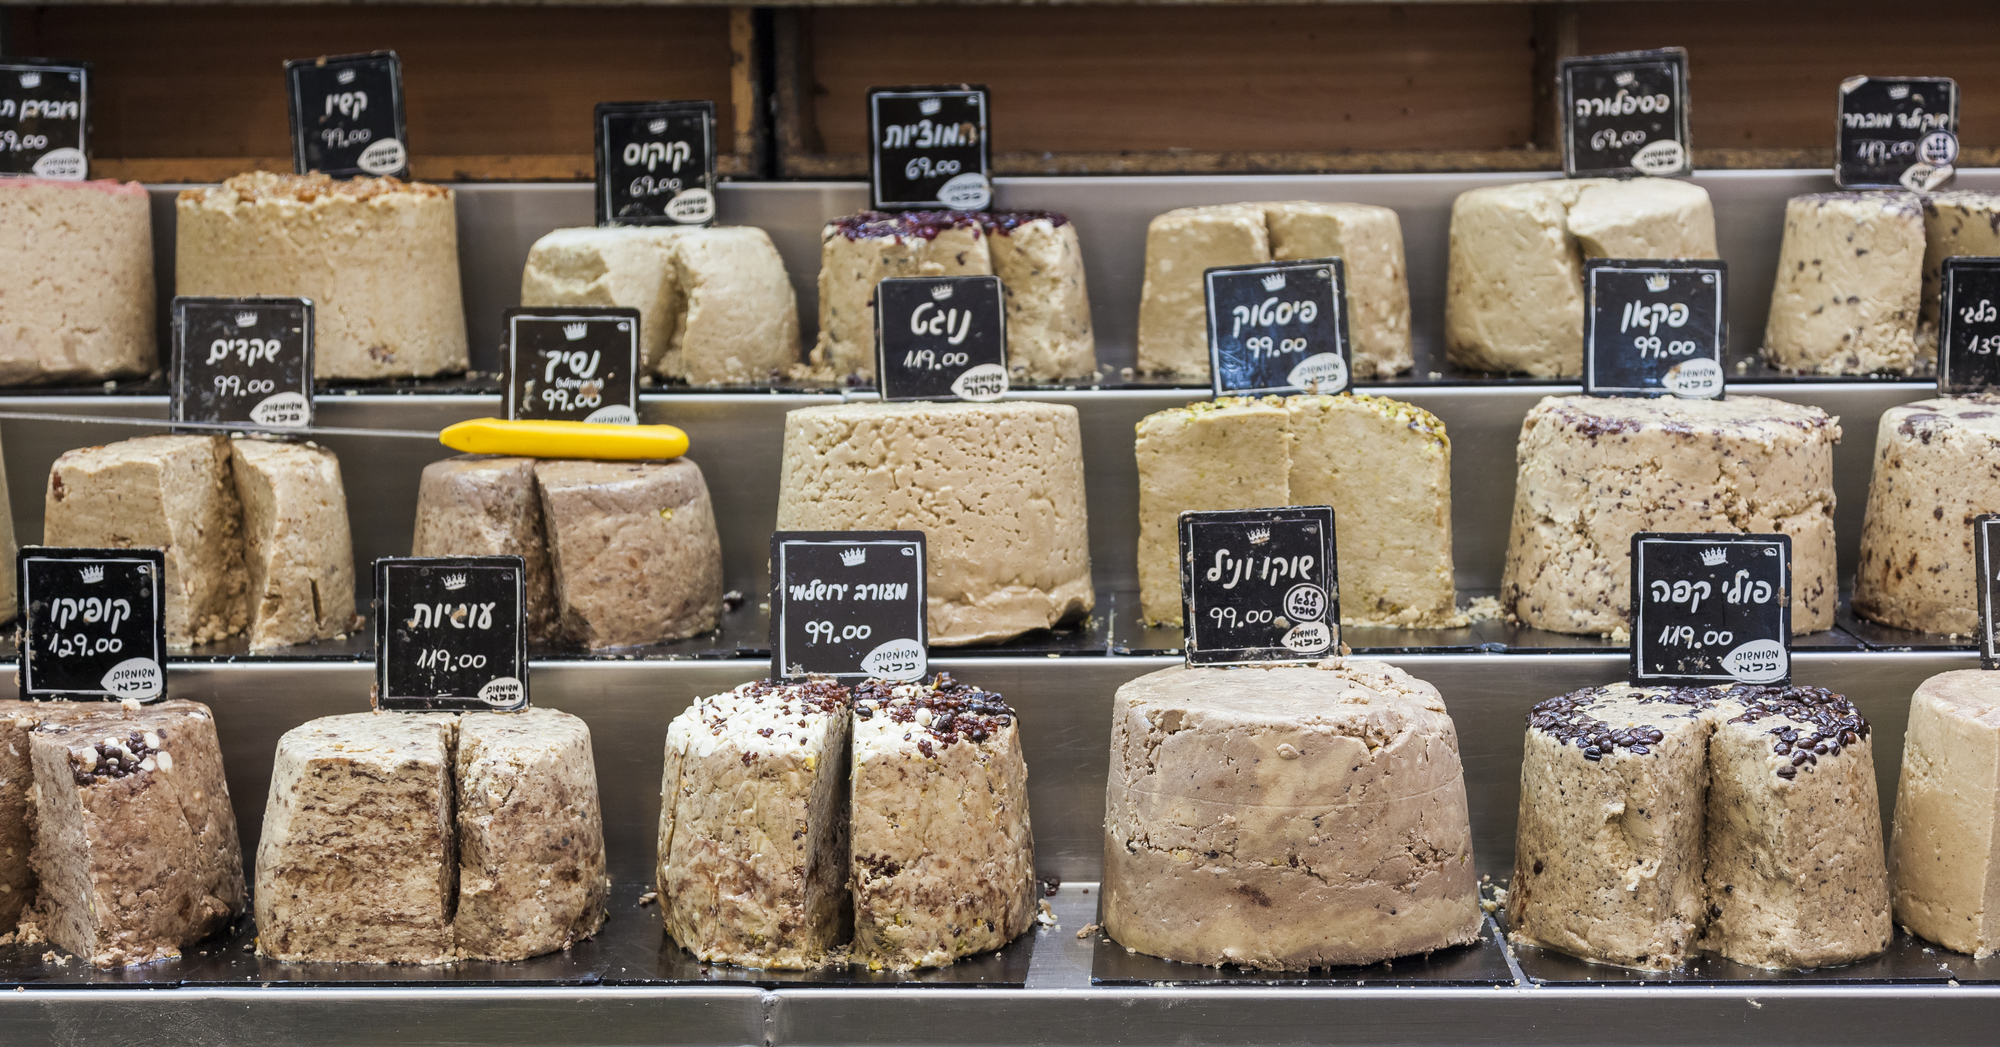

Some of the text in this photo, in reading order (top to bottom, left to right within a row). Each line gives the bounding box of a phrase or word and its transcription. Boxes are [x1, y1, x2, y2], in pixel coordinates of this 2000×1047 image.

[325, 90, 368, 121] קשיו
[322, 127, 371, 149] 99.00
[1590, 127, 1647, 152] 69.00
[1857, 140, 1916, 160] 119.00
[623, 140, 691, 174] קוקוס
[905, 156, 961, 181] 69.00
[630, 175, 683, 198] 69.00
[910, 302, 972, 345] נוגט
[1232, 297, 1318, 339] פיסטוק
[1620, 300, 1690, 336] פקאן
[1959, 299, 1998, 324] בלגי
[205, 338, 282, 368] שקדים
[1246, 336, 1307, 359] 99.00
[1634, 336, 1696, 359] 99.00
[544, 349, 601, 383] נסיך
[903, 349, 969, 371] 119.00
[214, 374, 275, 397] 99.00
[963, 384, 1001, 396] טהור
[542, 388, 602, 412] 99.00
[1207, 549, 1314, 589] שוקו וניל
[789, 579, 909, 601] מעורב ירושלמי
[1294, 590, 1319, 607] ללא
[1651, 569, 1772, 613] פולי קפה
[51, 597, 131, 634] קופיקו
[1210, 606, 1273, 629] 99.00
[1292, 605, 1317, 617] סוכר
[804, 620, 872, 644] 99.00
[1658, 625, 1733, 649] 119.00
[48, 633, 123, 658] 129.00
[417, 649, 487, 672] 119.00
[878, 662, 916, 673] מלא
[1738, 662, 1777, 673] מלא
[117, 681, 153, 691] מלא
